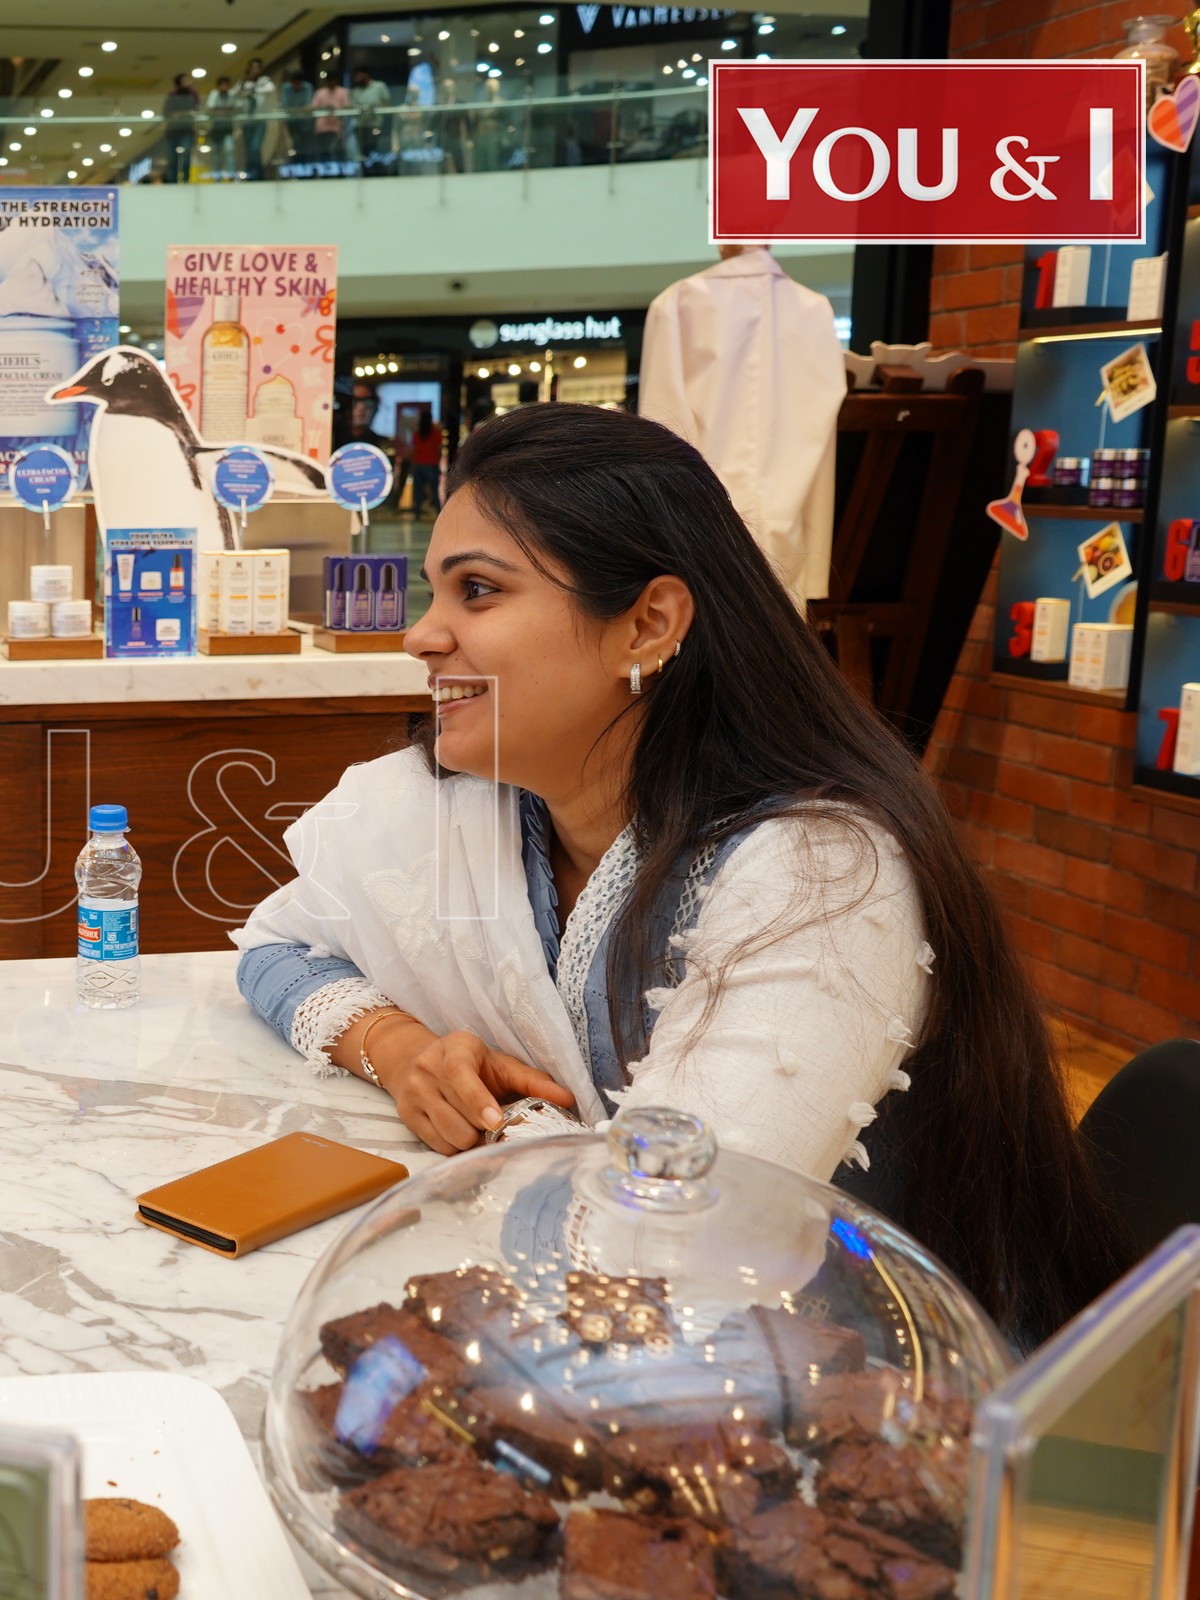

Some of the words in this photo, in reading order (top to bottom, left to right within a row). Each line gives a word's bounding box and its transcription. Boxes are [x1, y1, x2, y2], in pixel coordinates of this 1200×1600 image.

[1, 201, 28, 213] THE
[34, 201, 111, 213] STRENGTH
[19, 216, 111, 228] HYDRATION
[184, 252, 233, 272] GIVE
[241, 252, 298, 272] LOVE
[304, 253, 318, 273] &
[174, 276, 267, 297] HEALTHY
[275, 276, 327, 297] SKIN
[500, 317, 585, 346] sunglass
[585, 315, 622, 339] hut
